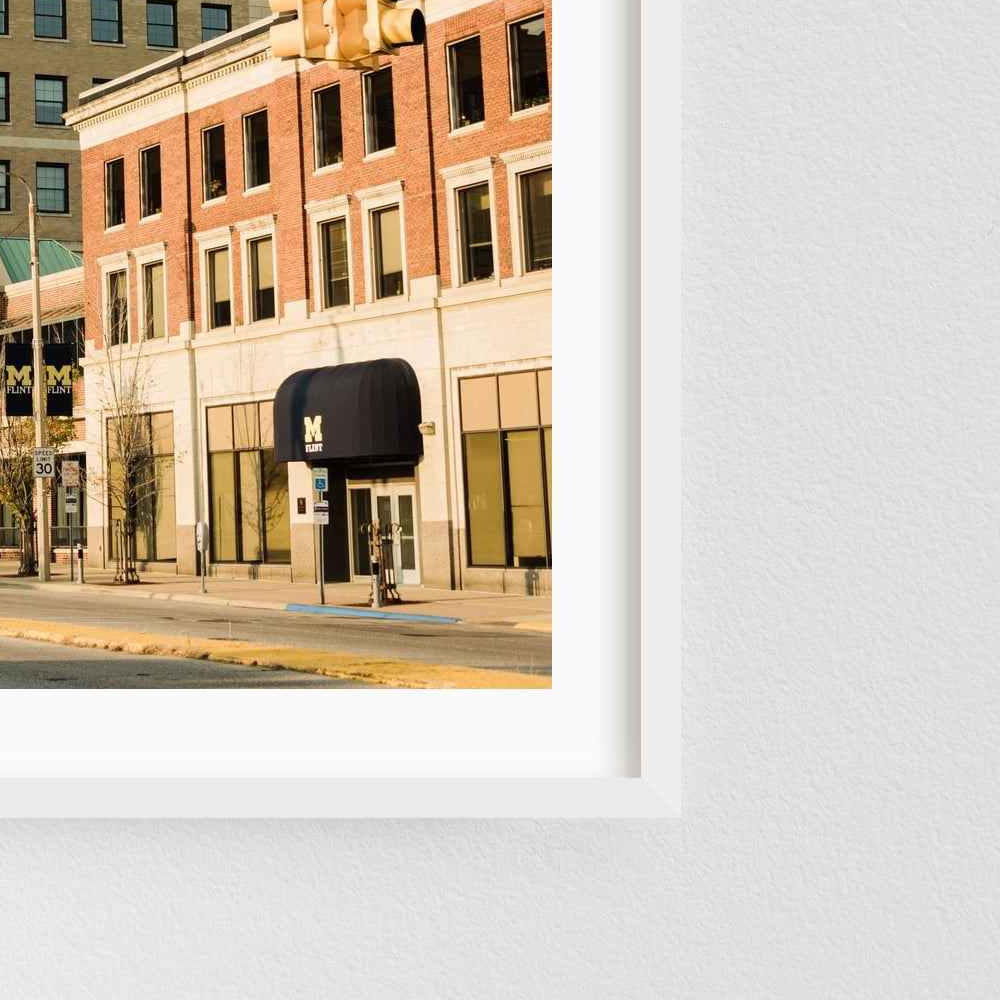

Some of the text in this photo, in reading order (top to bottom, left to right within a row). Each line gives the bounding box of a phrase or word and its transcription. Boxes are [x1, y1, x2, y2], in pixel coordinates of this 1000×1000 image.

[6, 365, 32, 386] M
[46, 365, 72, 386] M
[6, 386, 31, 394] FLINT
[47, 386, 72, 394] FLINT
[303, 415, 323, 443] M
[304, 443, 323, 453] FLINT
[36, 462, 53, 475] 30
